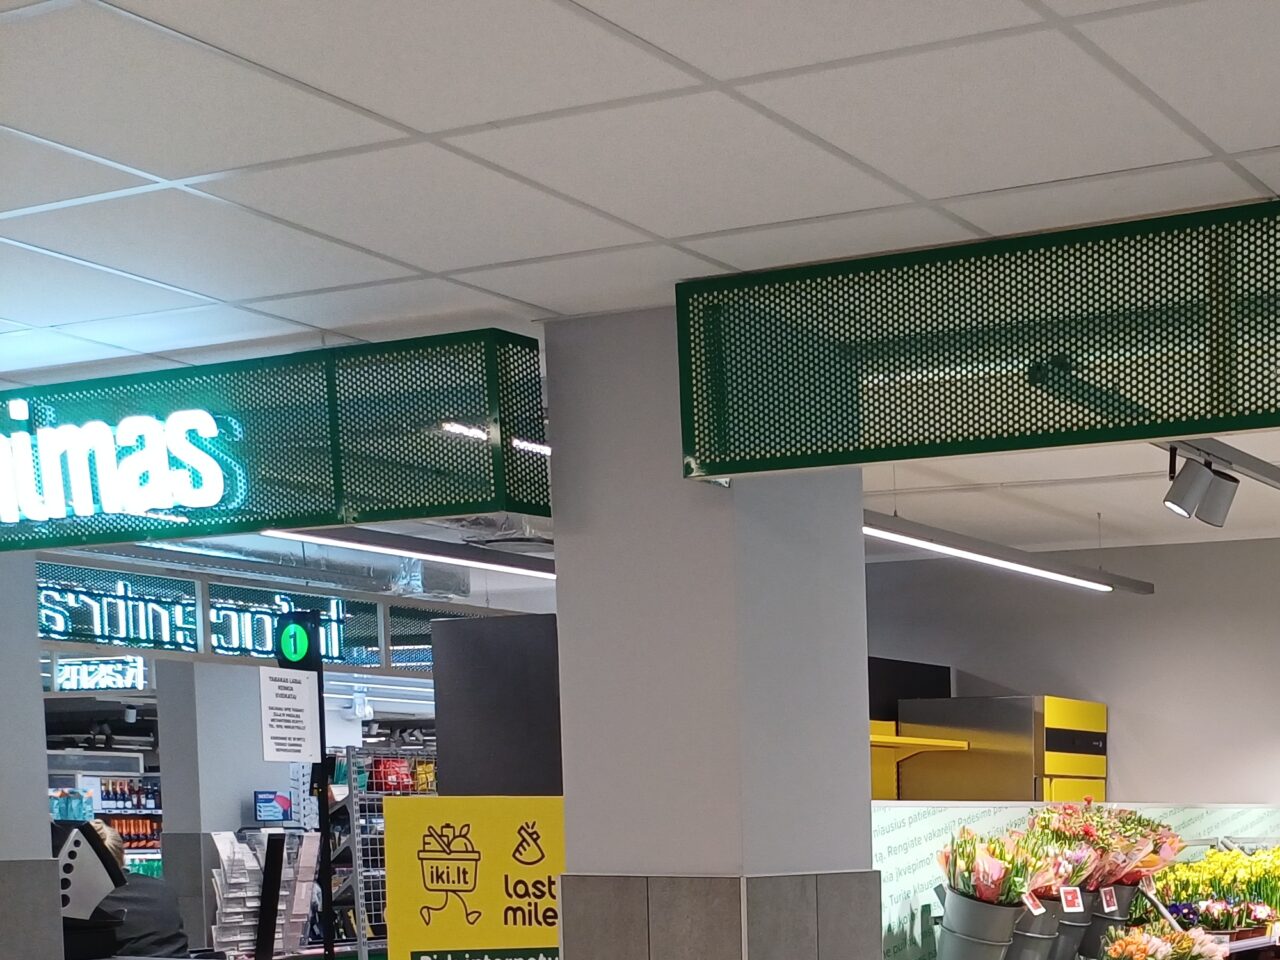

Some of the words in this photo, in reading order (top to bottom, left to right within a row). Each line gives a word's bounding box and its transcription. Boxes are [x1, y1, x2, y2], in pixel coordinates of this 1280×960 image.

[289, 630, 298, 656] 1
[887, 834, 922, 858] Rengiate
[430, 865, 469, 885] iki.lt
[504, 874, 557, 900] last
[504, 902, 558, 927] mile
